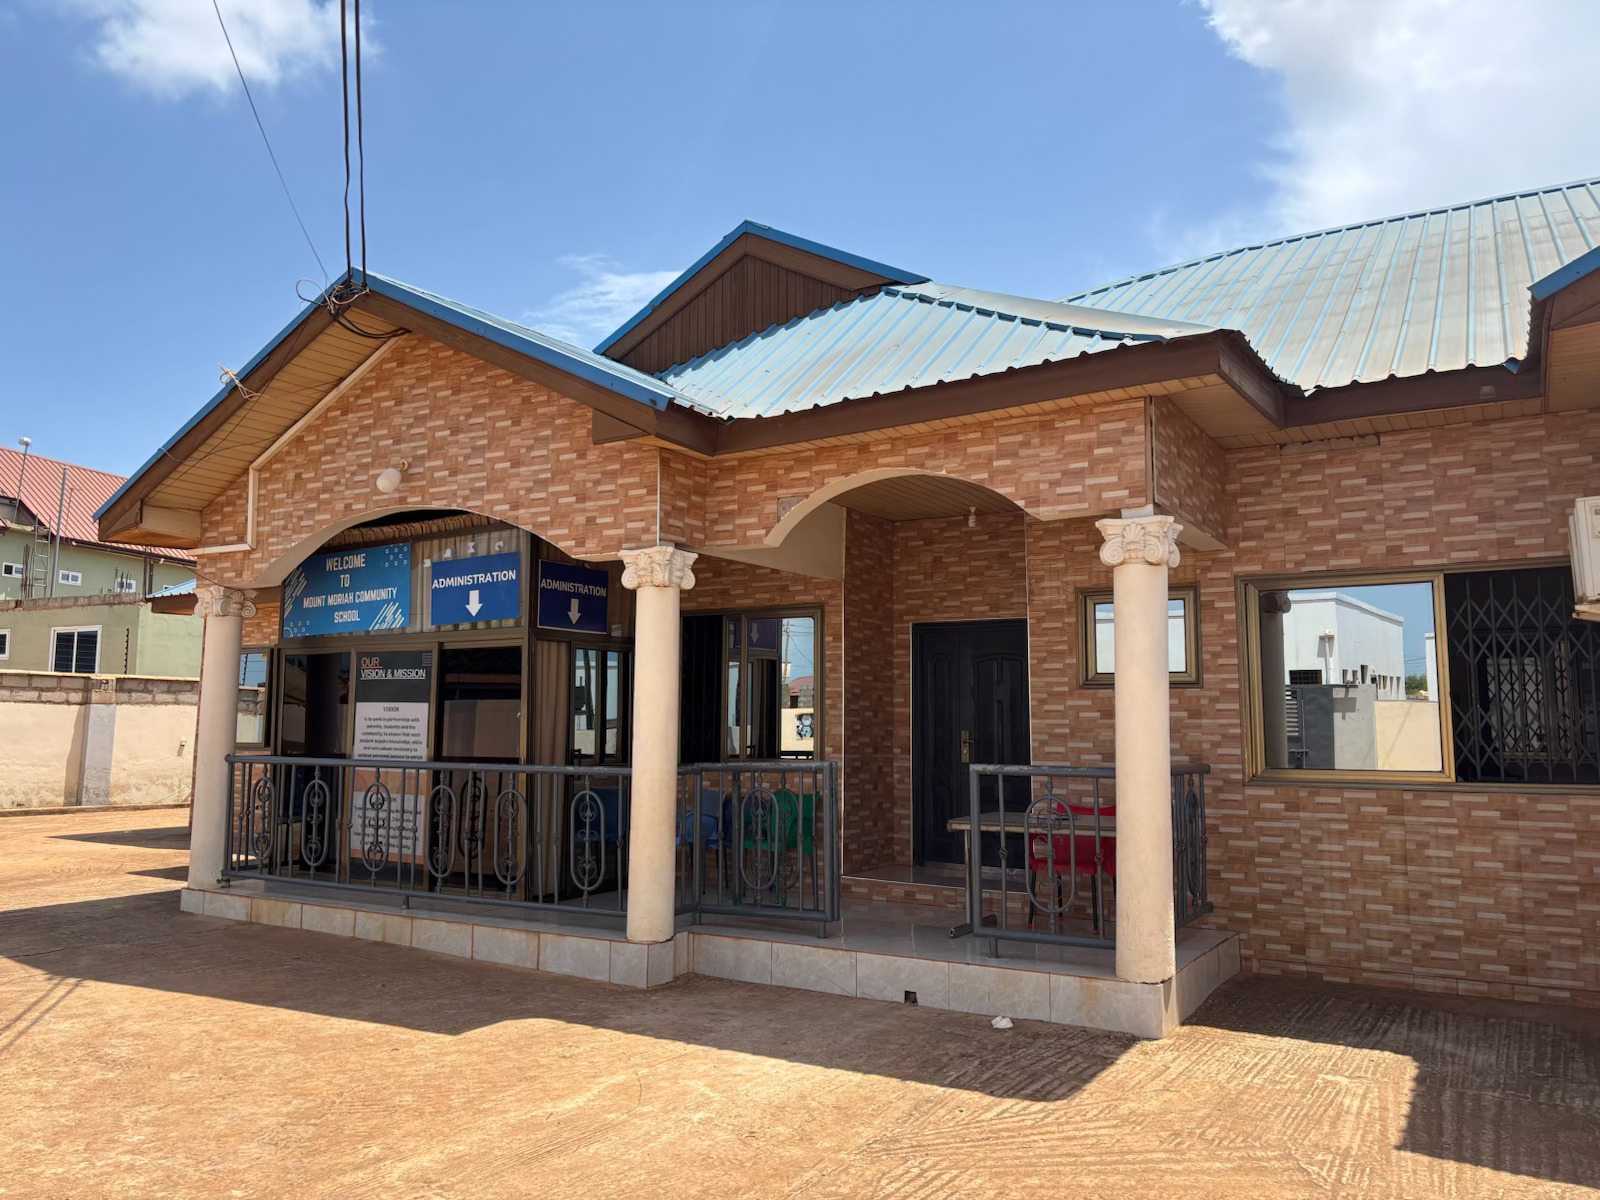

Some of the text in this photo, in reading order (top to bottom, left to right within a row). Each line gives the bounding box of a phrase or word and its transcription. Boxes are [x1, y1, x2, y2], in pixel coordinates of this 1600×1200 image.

[326, 554, 366, 571] WELCOME
[340, 574, 350, 588] TO
[432, 569, 516, 589] ADMINISTRATION
[540, 578, 607, 597] ADMINISTRATION
[303, 587, 398, 608] MOUNT MORIAH COMMUNITY
[334, 610, 360, 623] SCHOOL
[361, 657, 380, 667] OUR
[360, 668, 426, 678] VISION & MISSION
